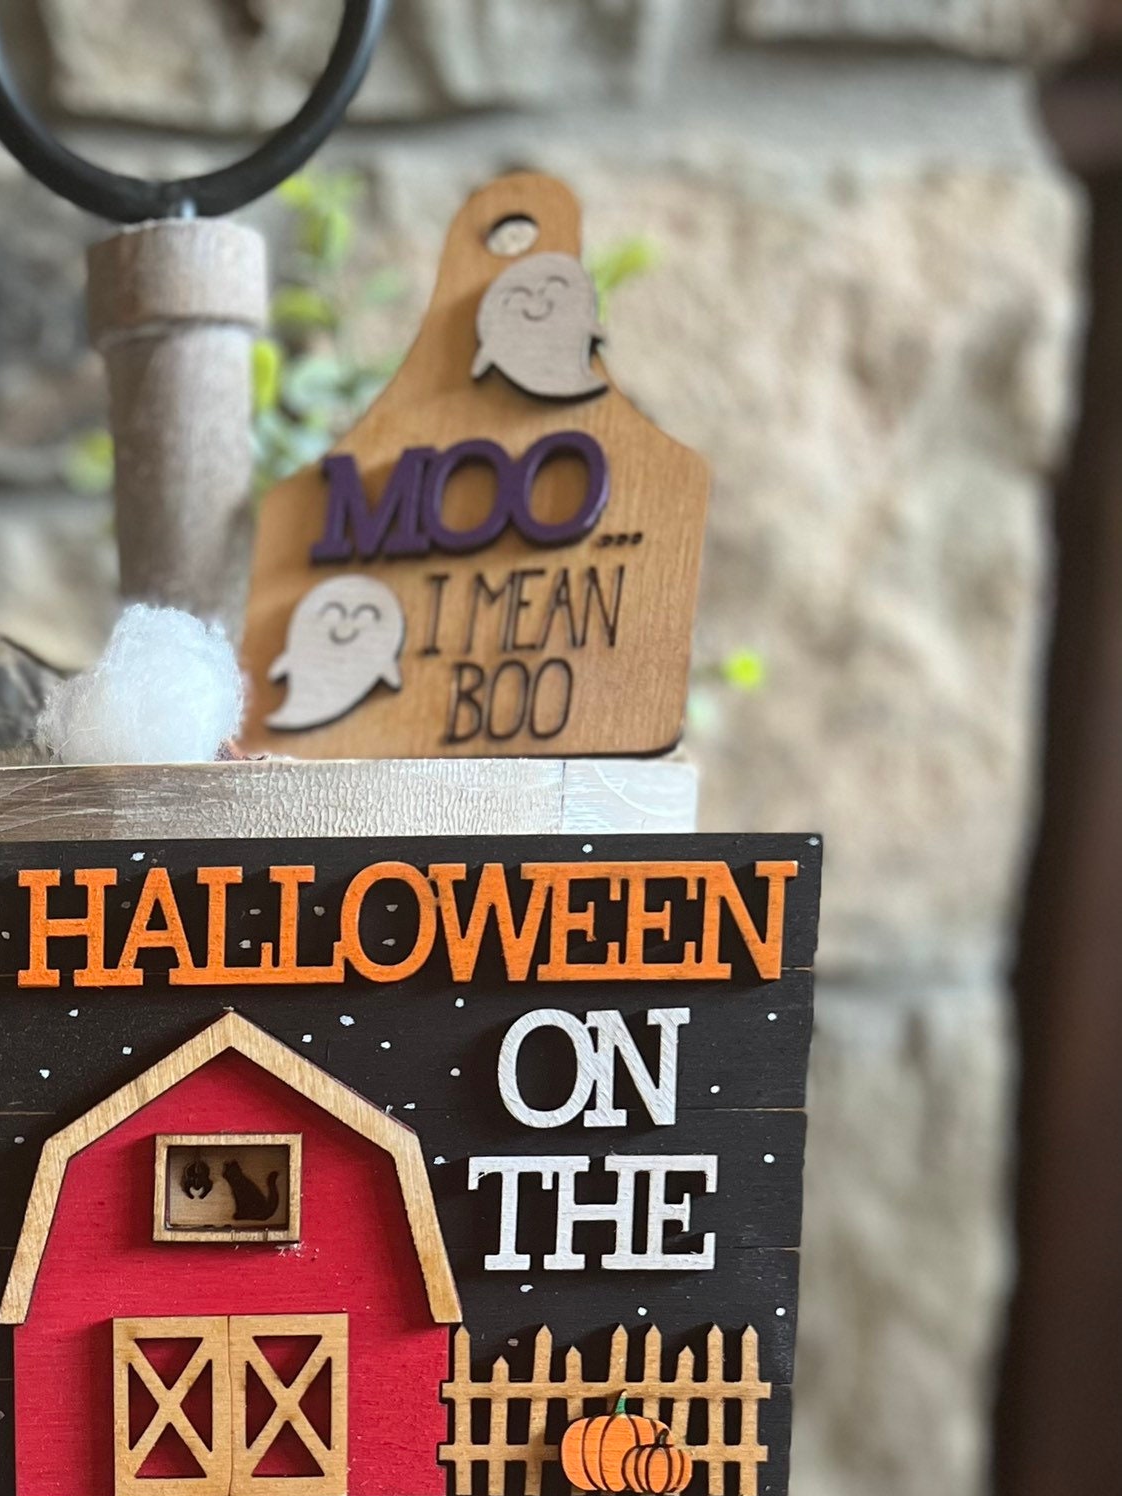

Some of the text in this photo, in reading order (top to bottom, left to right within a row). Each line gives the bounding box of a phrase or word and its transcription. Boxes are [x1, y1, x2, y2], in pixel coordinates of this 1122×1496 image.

[417, 565, 626, 656] I MEAN
[444, 657, 573, 745] BOO
[17, 861, 798, 988] HALLOWEEN
[497, 1007, 690, 1129] ON
[468, 1154, 719, 1271] THE
